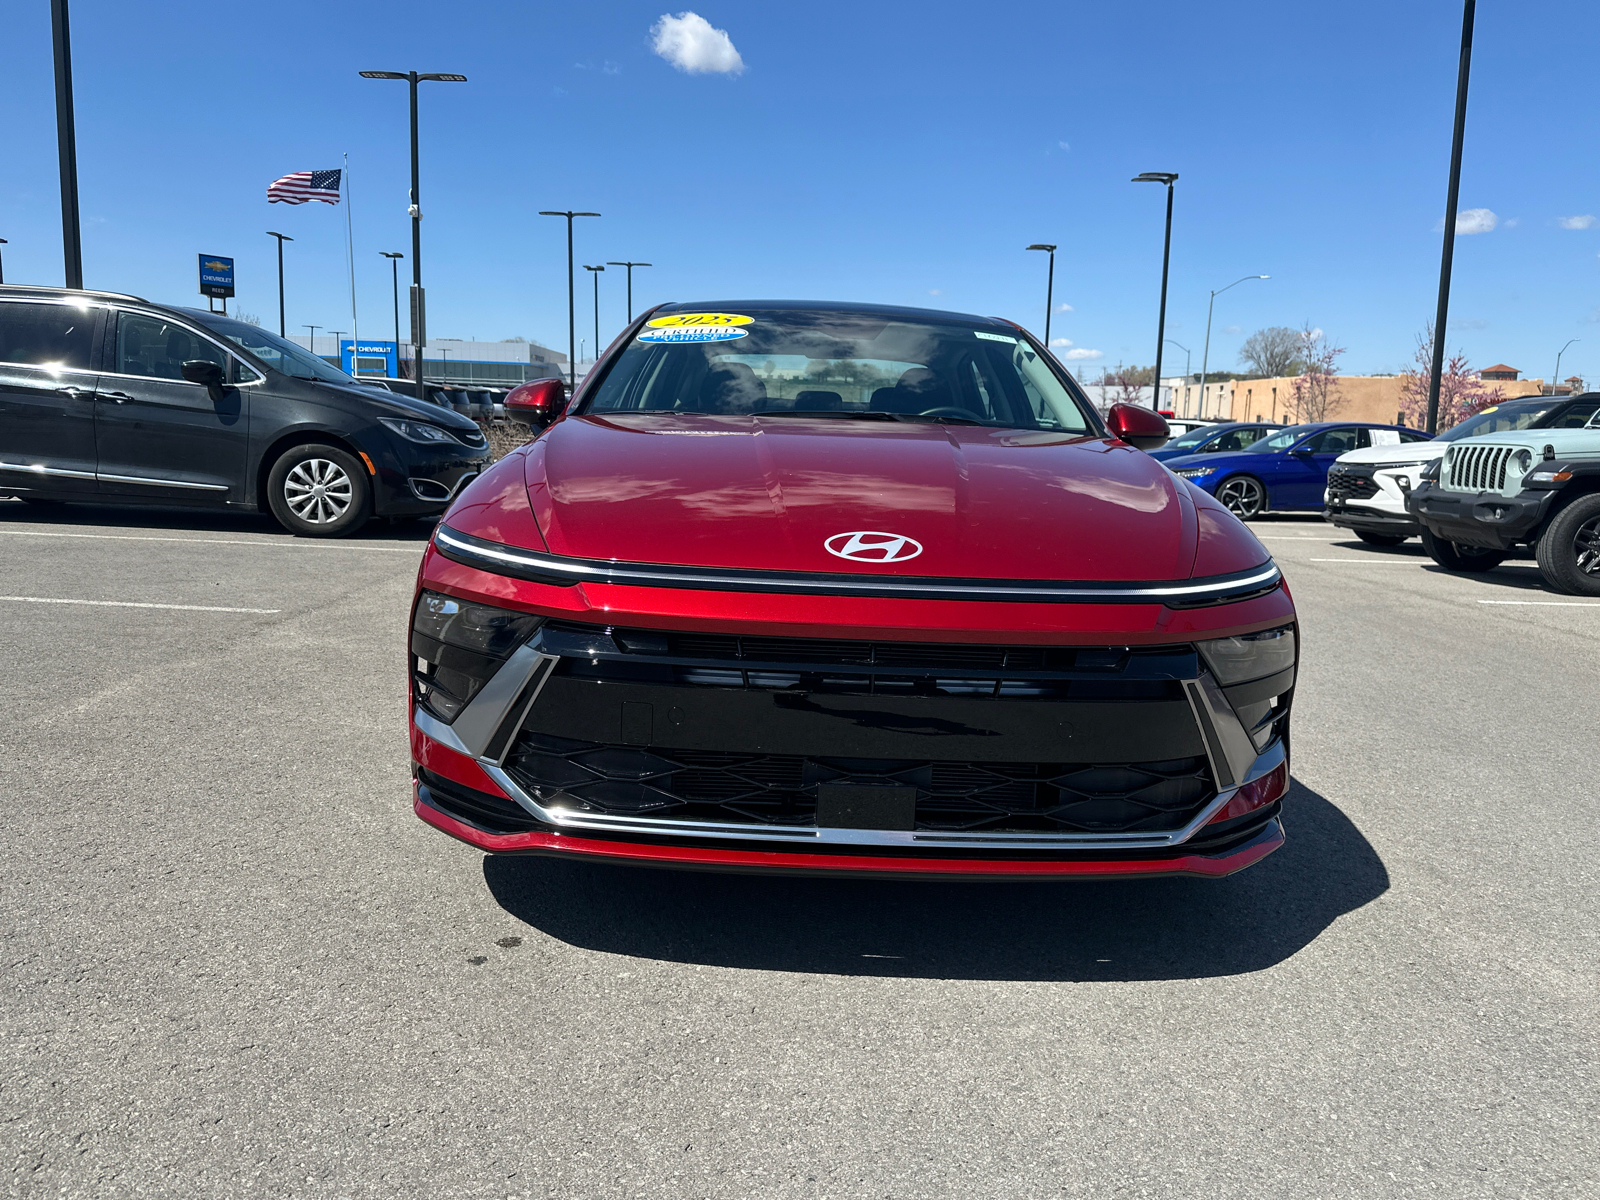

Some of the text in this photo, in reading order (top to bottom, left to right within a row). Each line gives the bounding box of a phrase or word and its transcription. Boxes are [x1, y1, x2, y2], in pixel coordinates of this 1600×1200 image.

[203, 275, 232, 283] CHEVROLET
[662, 316, 739, 326] 2025
[651, 328, 737, 336] CERTIFIED
